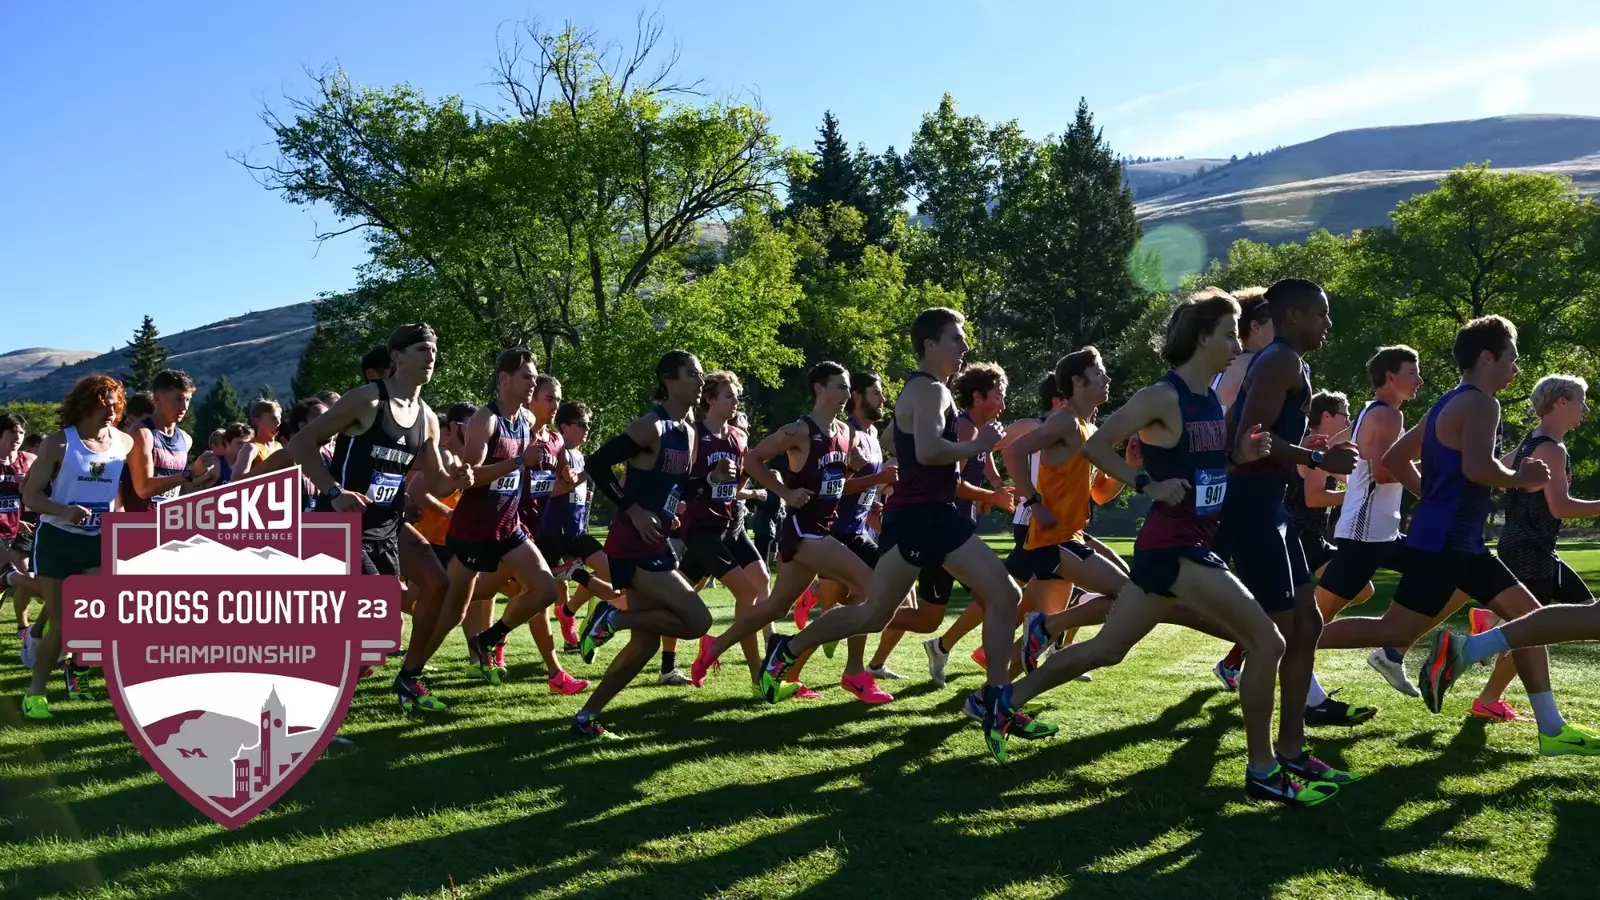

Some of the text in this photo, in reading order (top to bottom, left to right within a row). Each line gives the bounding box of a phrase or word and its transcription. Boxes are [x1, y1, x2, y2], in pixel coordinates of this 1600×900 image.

[497, 478, 515, 490] 944
[534, 480, 550, 492] 991
[375, 486, 396, 501] 917
[717, 485, 734, 498] 990
[1204, 485, 1223, 504] 941
